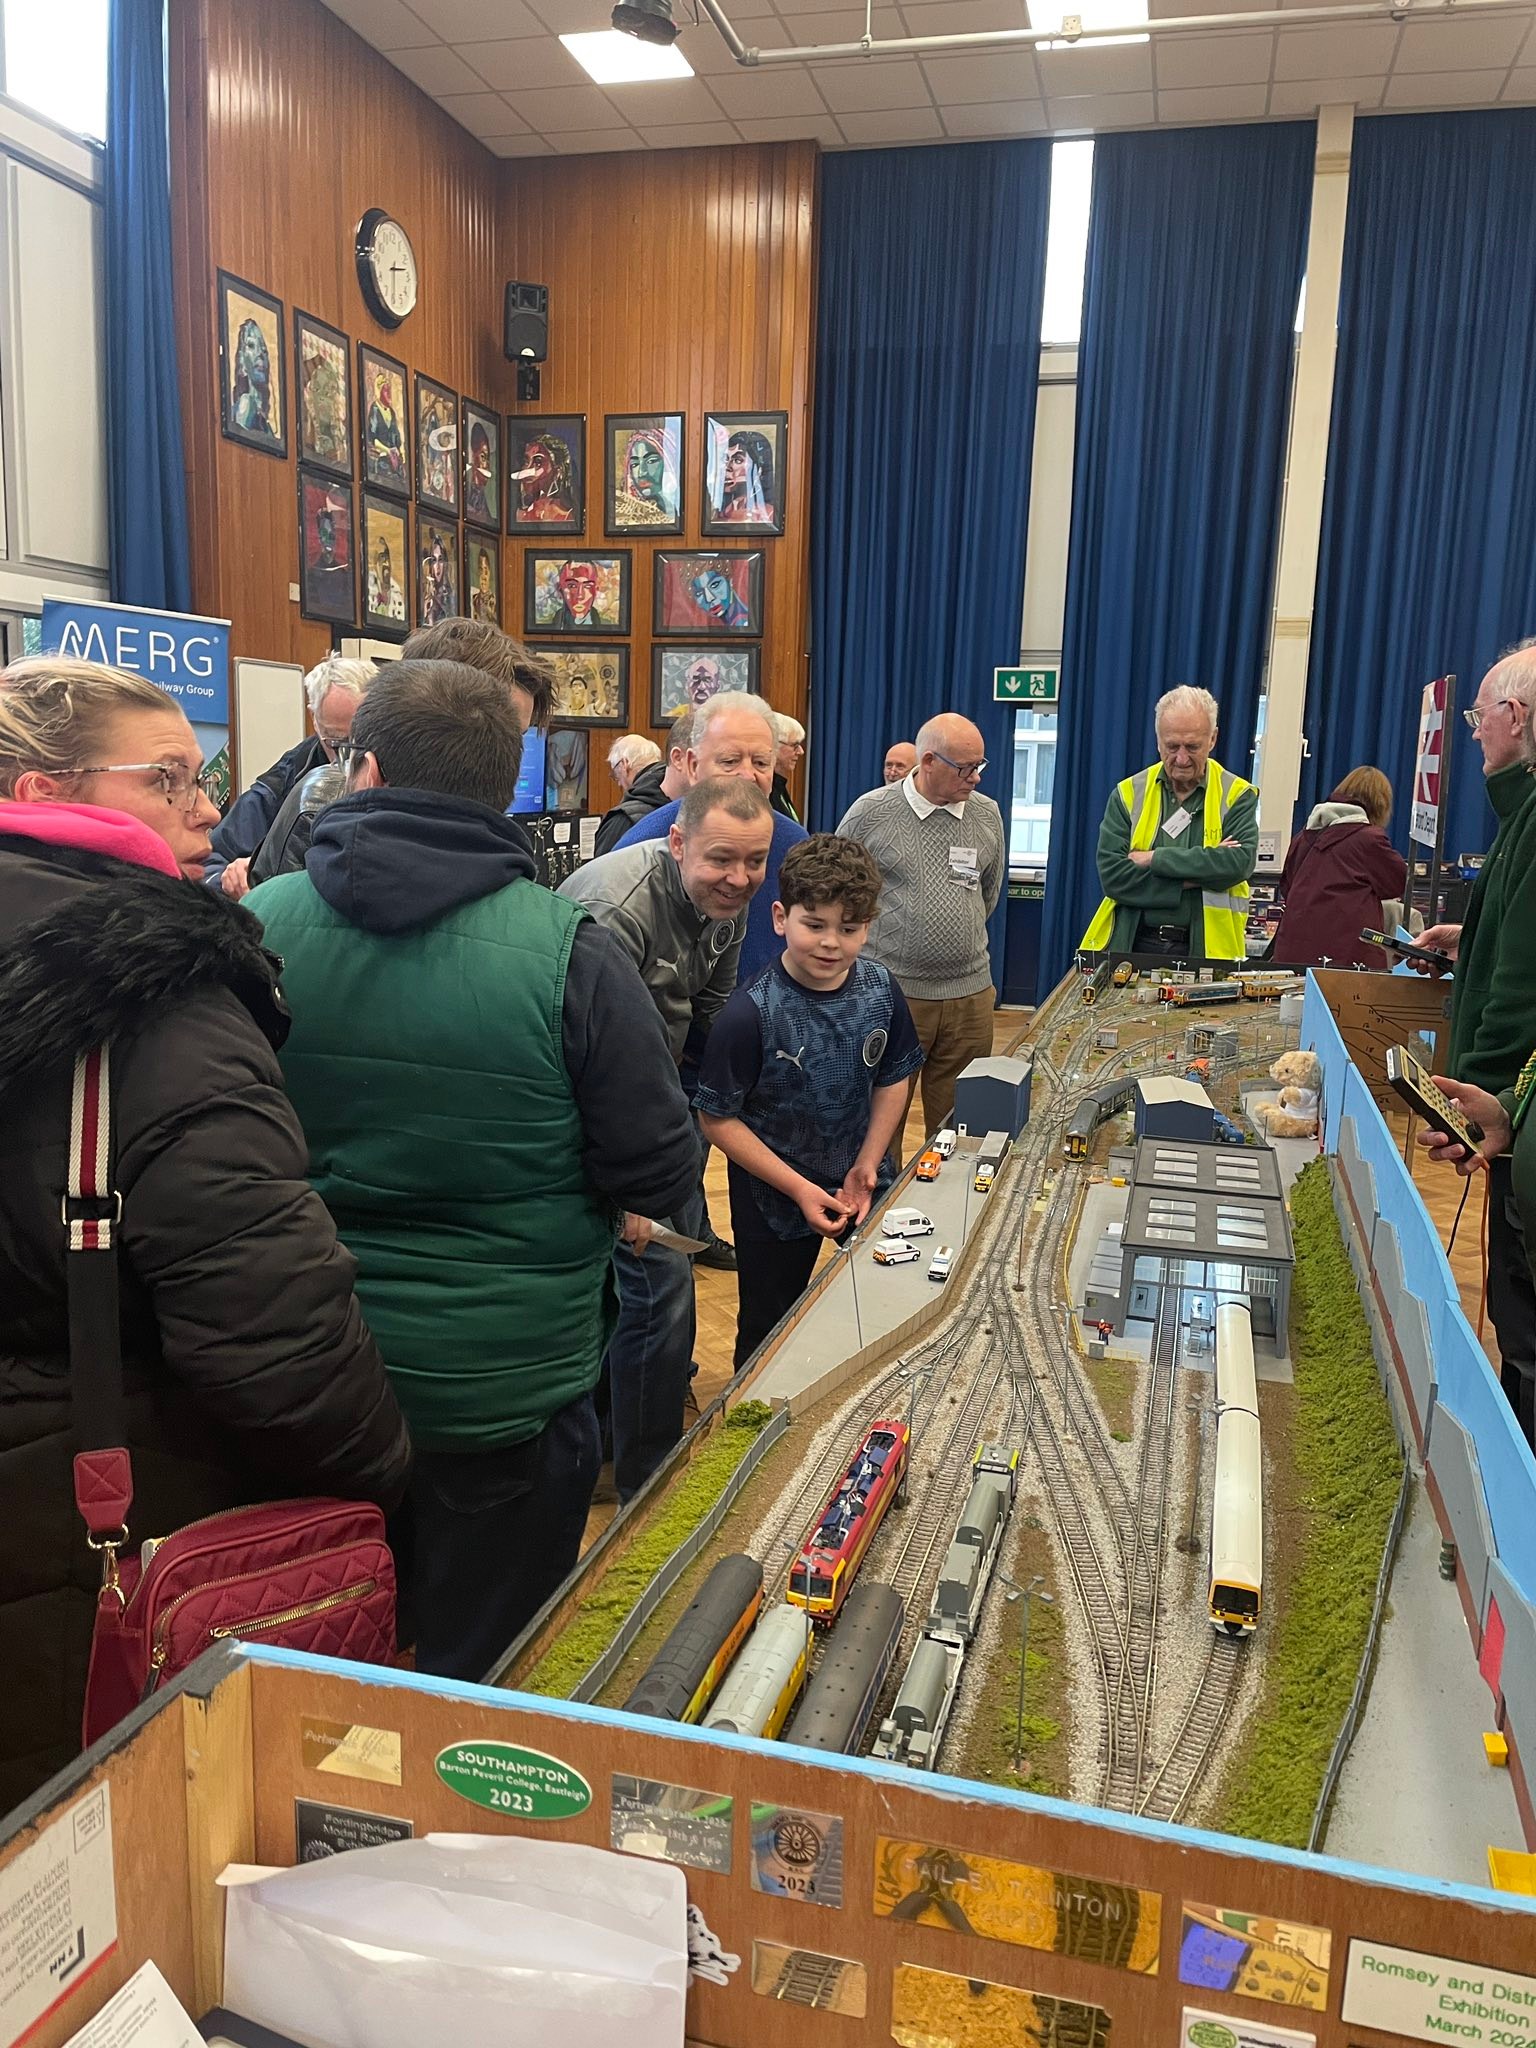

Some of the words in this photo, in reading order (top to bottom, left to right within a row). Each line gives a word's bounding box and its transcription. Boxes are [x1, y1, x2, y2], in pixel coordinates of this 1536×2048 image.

[59, 620, 213, 677] MERG
[153, 681, 184, 695] ilway
[186, 684, 214, 698] Group
[1021, 888, 1030, 896] to
[456, 1750, 569, 1785] SOUTHAMPTON
[439, 1761, 471, 1777] Barton
[472, 1768, 504, 1783] Peveril
[505, 1776, 543, 1793] College,
[544, 1783, 586, 1802] Eastleigh
[489, 1788, 534, 1812] 2023
[322, 1823, 357, 1840] Model
[325, 1814, 402, 1838] Fordingbridge
[778, 1874, 816, 1895] 2023
[1361, 1955, 1440, 1988] Romsey
[1447, 1977, 1484, 1995] and
[1439, 1994, 1530, 2028] Exhibition
[1425, 2014, 1482, 2040] March
